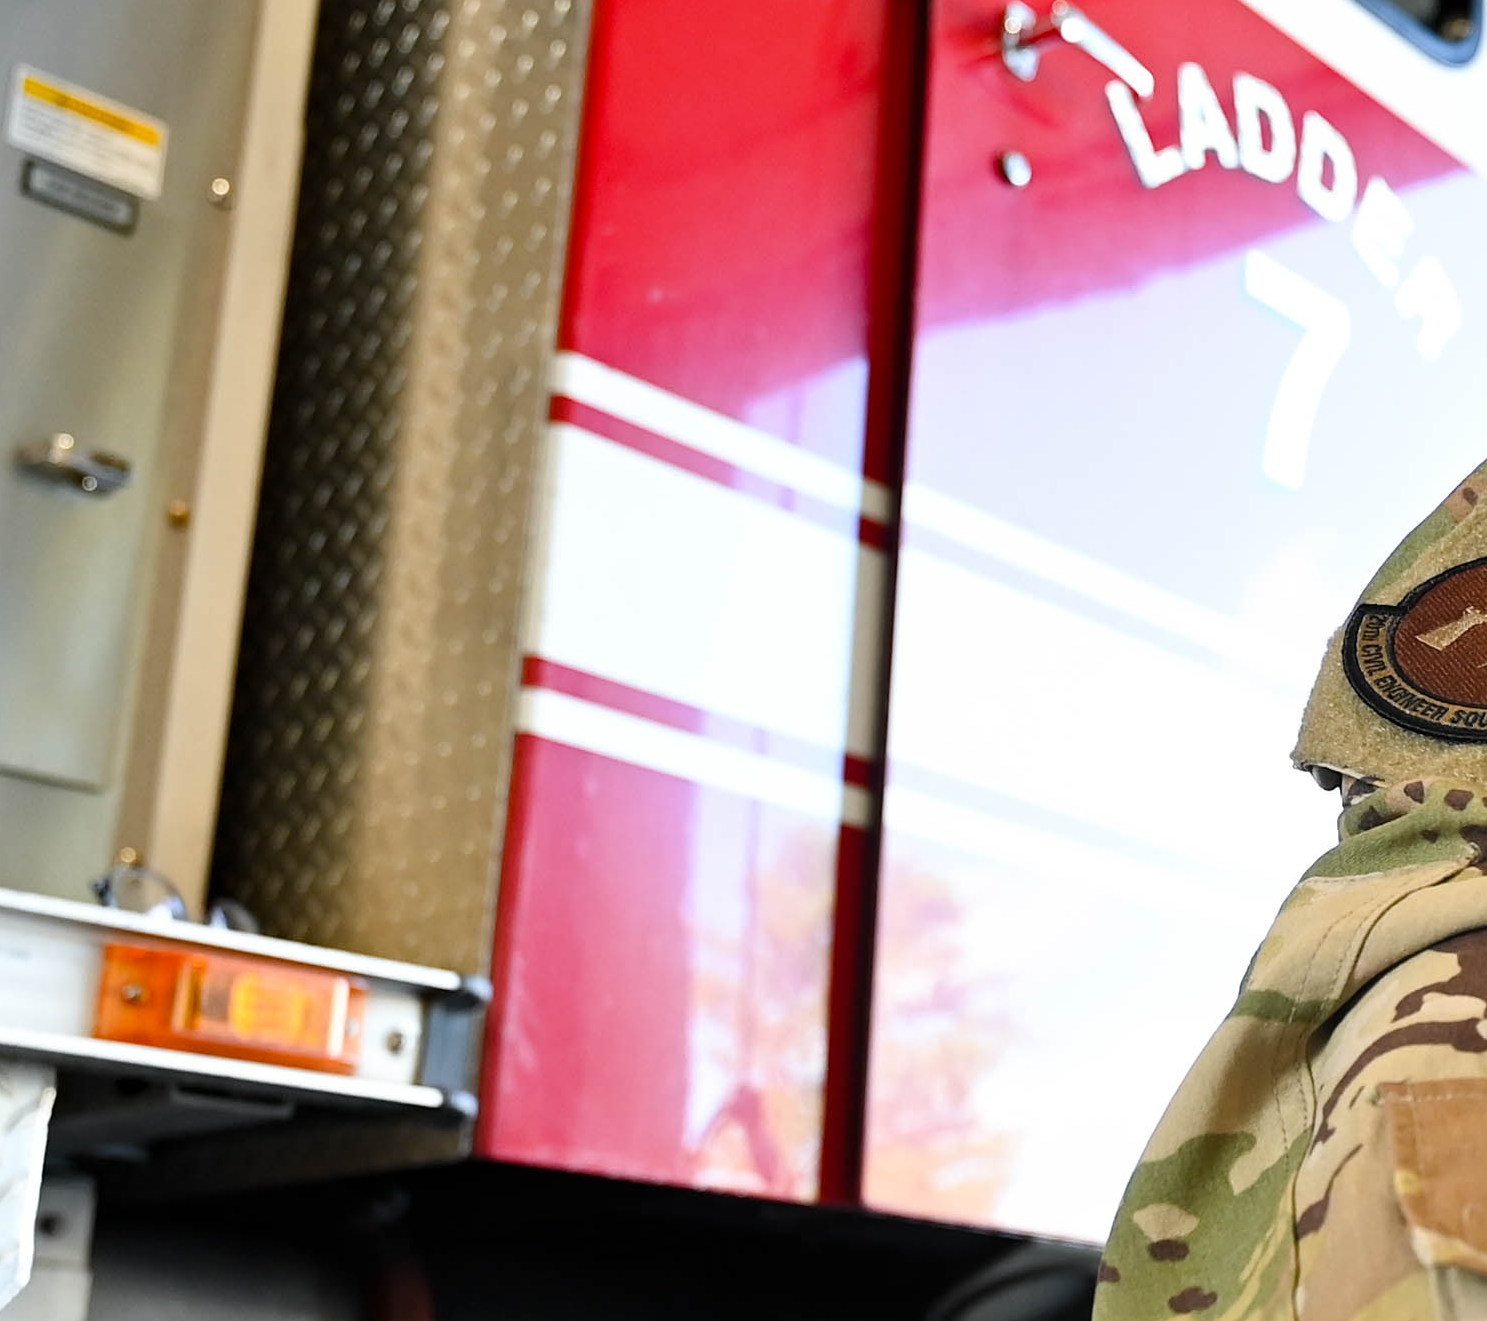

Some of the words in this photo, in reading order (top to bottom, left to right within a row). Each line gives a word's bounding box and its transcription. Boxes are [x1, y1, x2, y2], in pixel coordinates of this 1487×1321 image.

[1244, 248, 1351, 492] 7
[1361, 644, 1388, 676] CIVIL
[1374, 675, 1450, 721] ENGINEER
